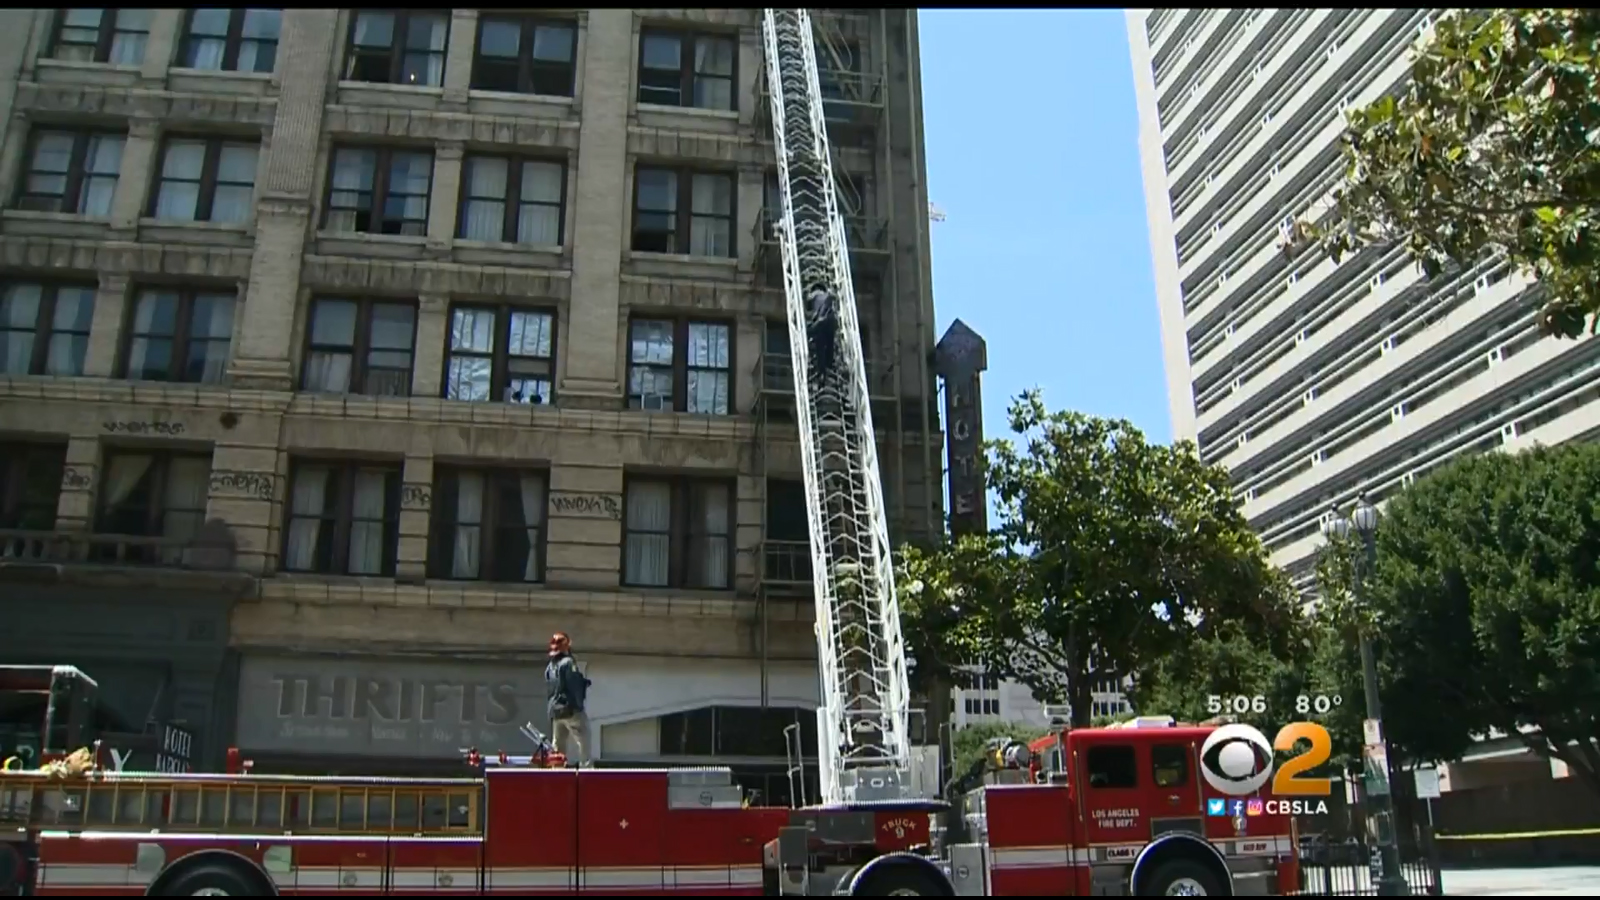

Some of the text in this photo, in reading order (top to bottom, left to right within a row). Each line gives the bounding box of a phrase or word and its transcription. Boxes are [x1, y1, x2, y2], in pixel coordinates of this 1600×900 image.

[271, 674, 519, 724] THRIFTS
[164, 725, 192, 758] HOTEL
[1091, 808, 1140, 819] LOS ANGELES
[881, 817, 917, 832] TRUCK
[1098, 819, 1115, 828] FIRE
